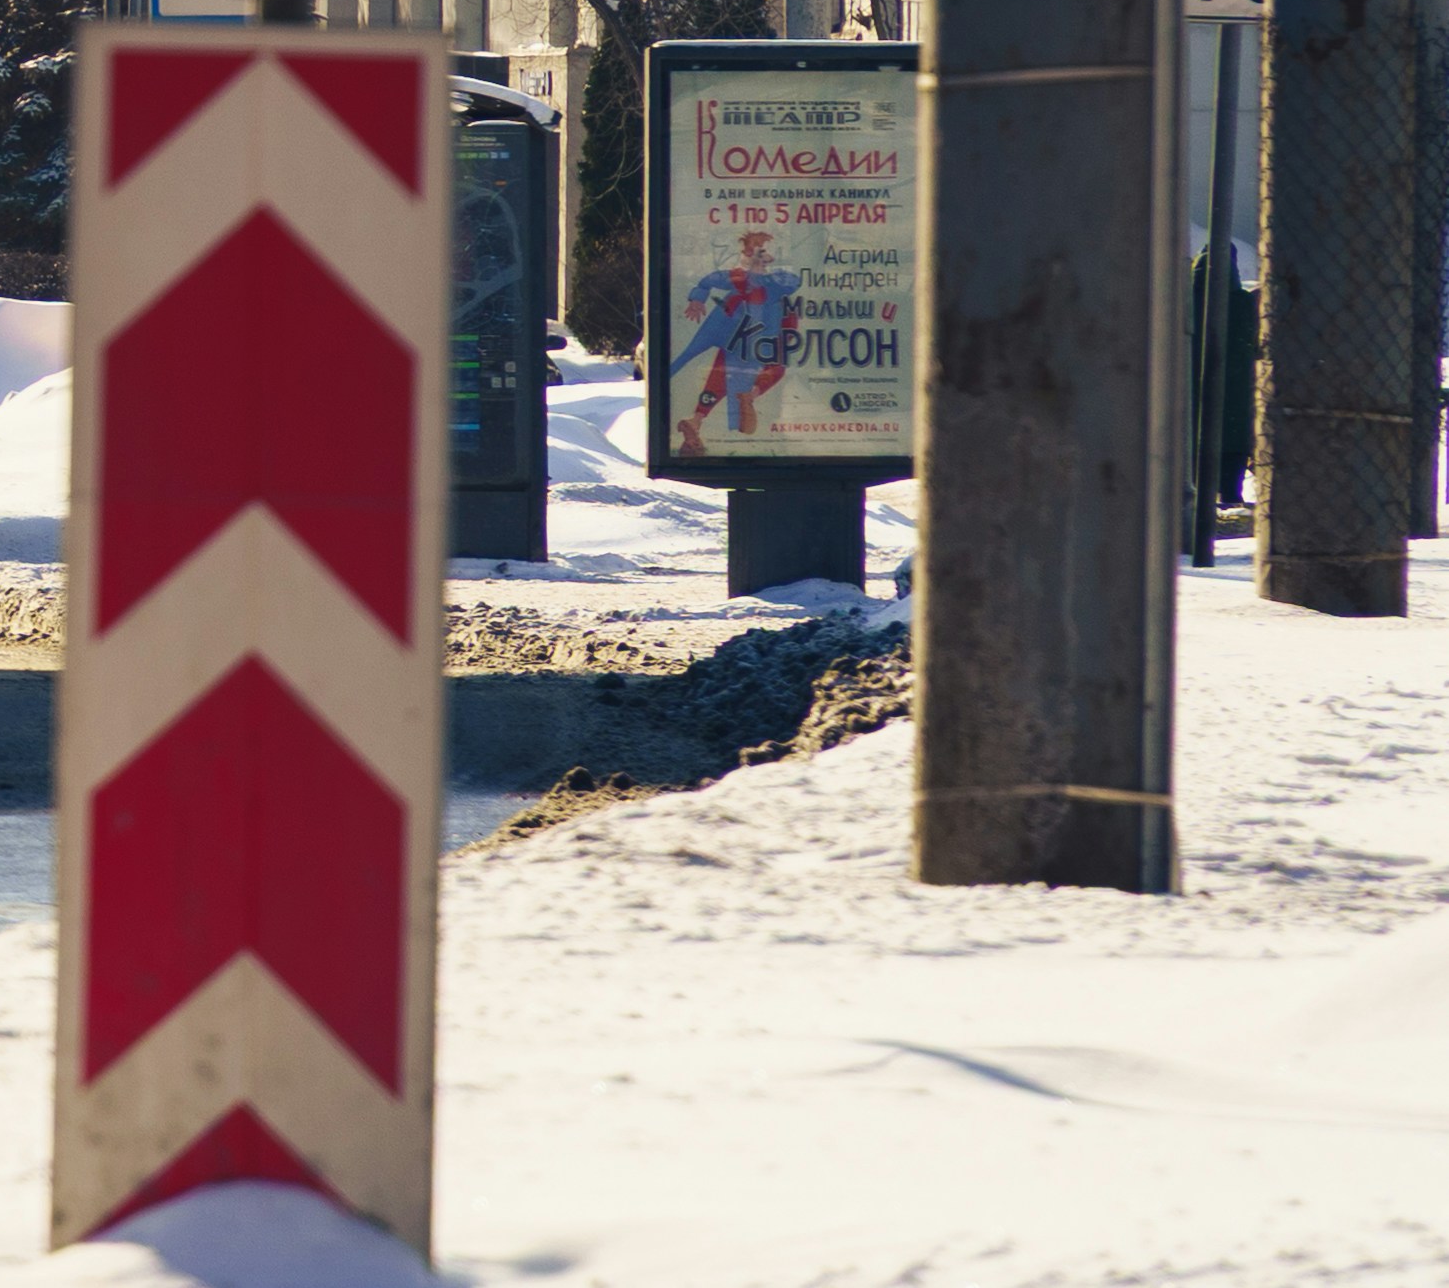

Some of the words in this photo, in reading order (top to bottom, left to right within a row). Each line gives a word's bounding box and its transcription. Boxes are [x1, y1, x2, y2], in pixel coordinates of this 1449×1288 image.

[717, 189, 746, 199] ДНИ
[751, 189, 824, 199] ШКОЛЬНЫХ
[830, 189, 891, 199] КАНИКУЛ
[728, 203, 738, 224] 1
[774, 203, 790, 224] 5
[796, 203, 887, 224] АПРЕЛЯ
[823, 245, 899, 268] Астрид
[800, 268, 899, 291] Линдгрен
[783, 296, 875, 320] Малыш
[702, 394, 717, 404] 6+
